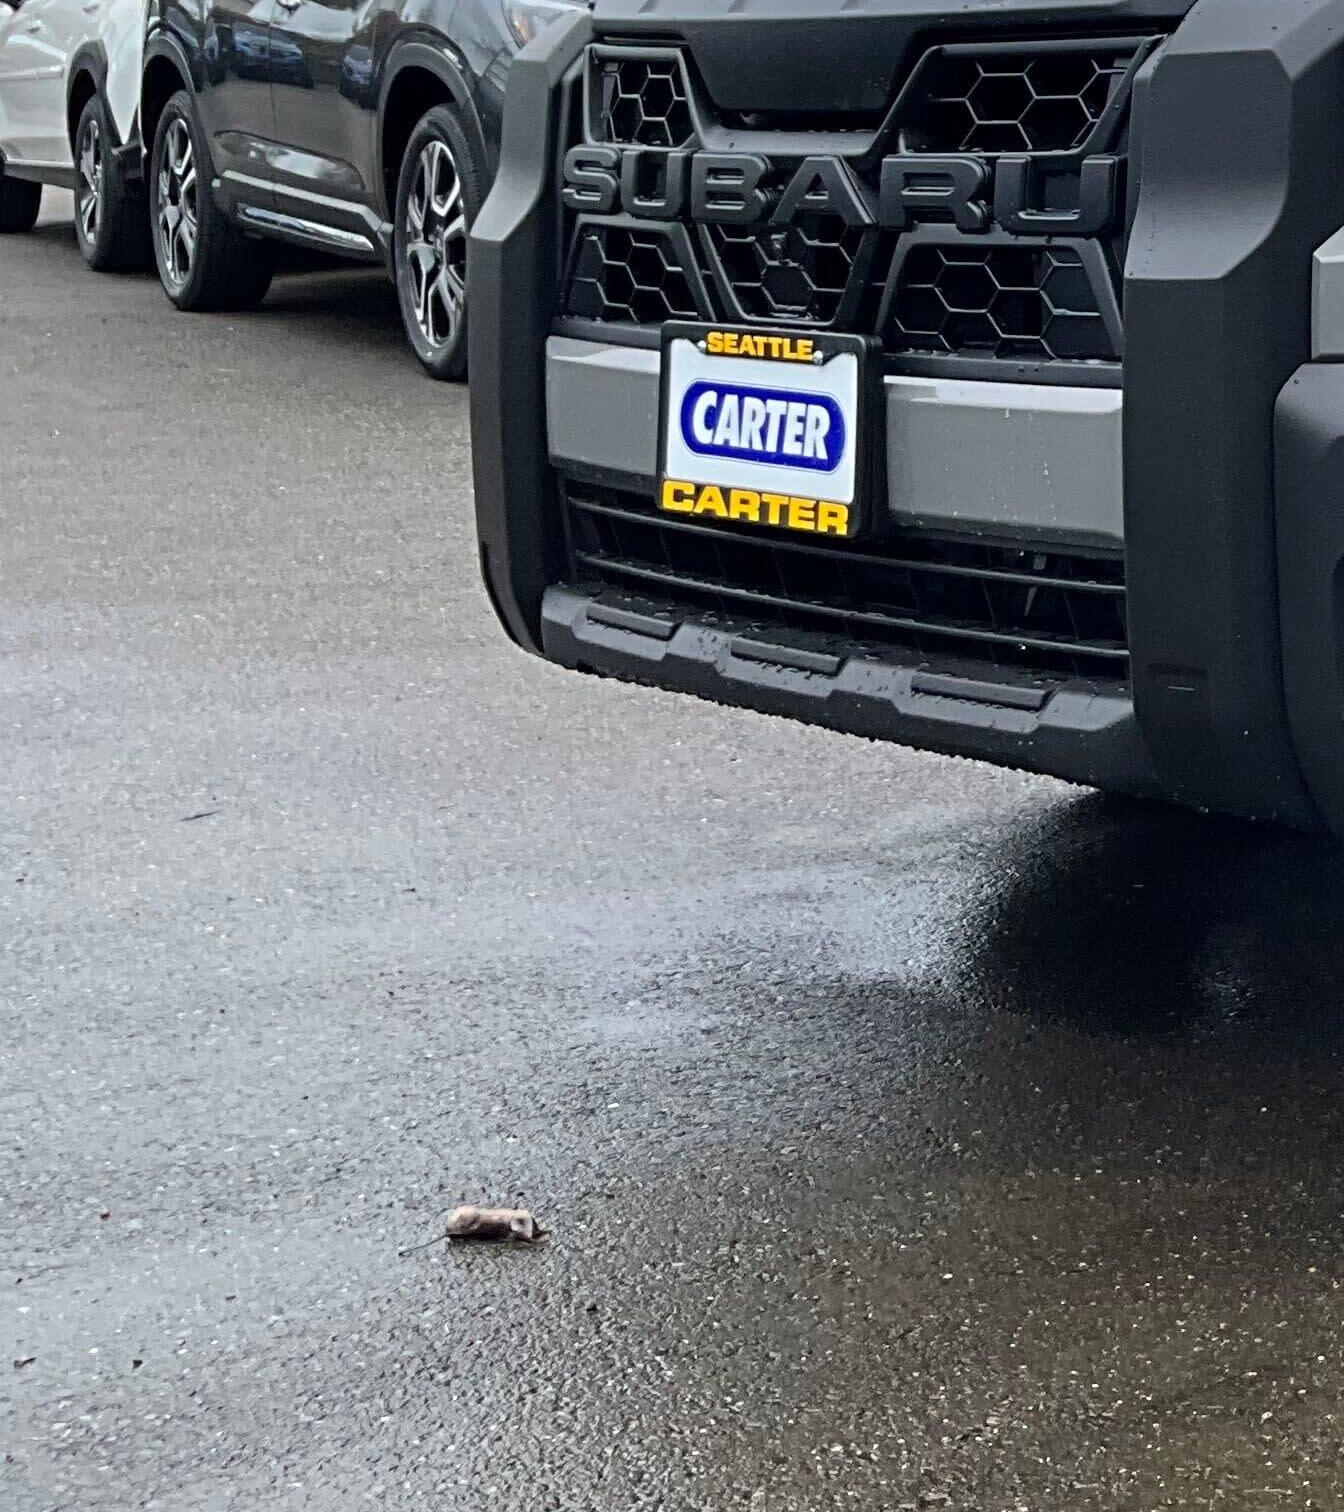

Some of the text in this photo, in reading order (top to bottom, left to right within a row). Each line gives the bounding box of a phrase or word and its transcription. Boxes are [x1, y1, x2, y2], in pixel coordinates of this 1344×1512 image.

[563, 143, 1129, 238] SUBARU
[706, 331, 815, 362] SEATTLE
[691, 389, 831, 461] CARTER
[661, 479, 850, 536] CARTER
